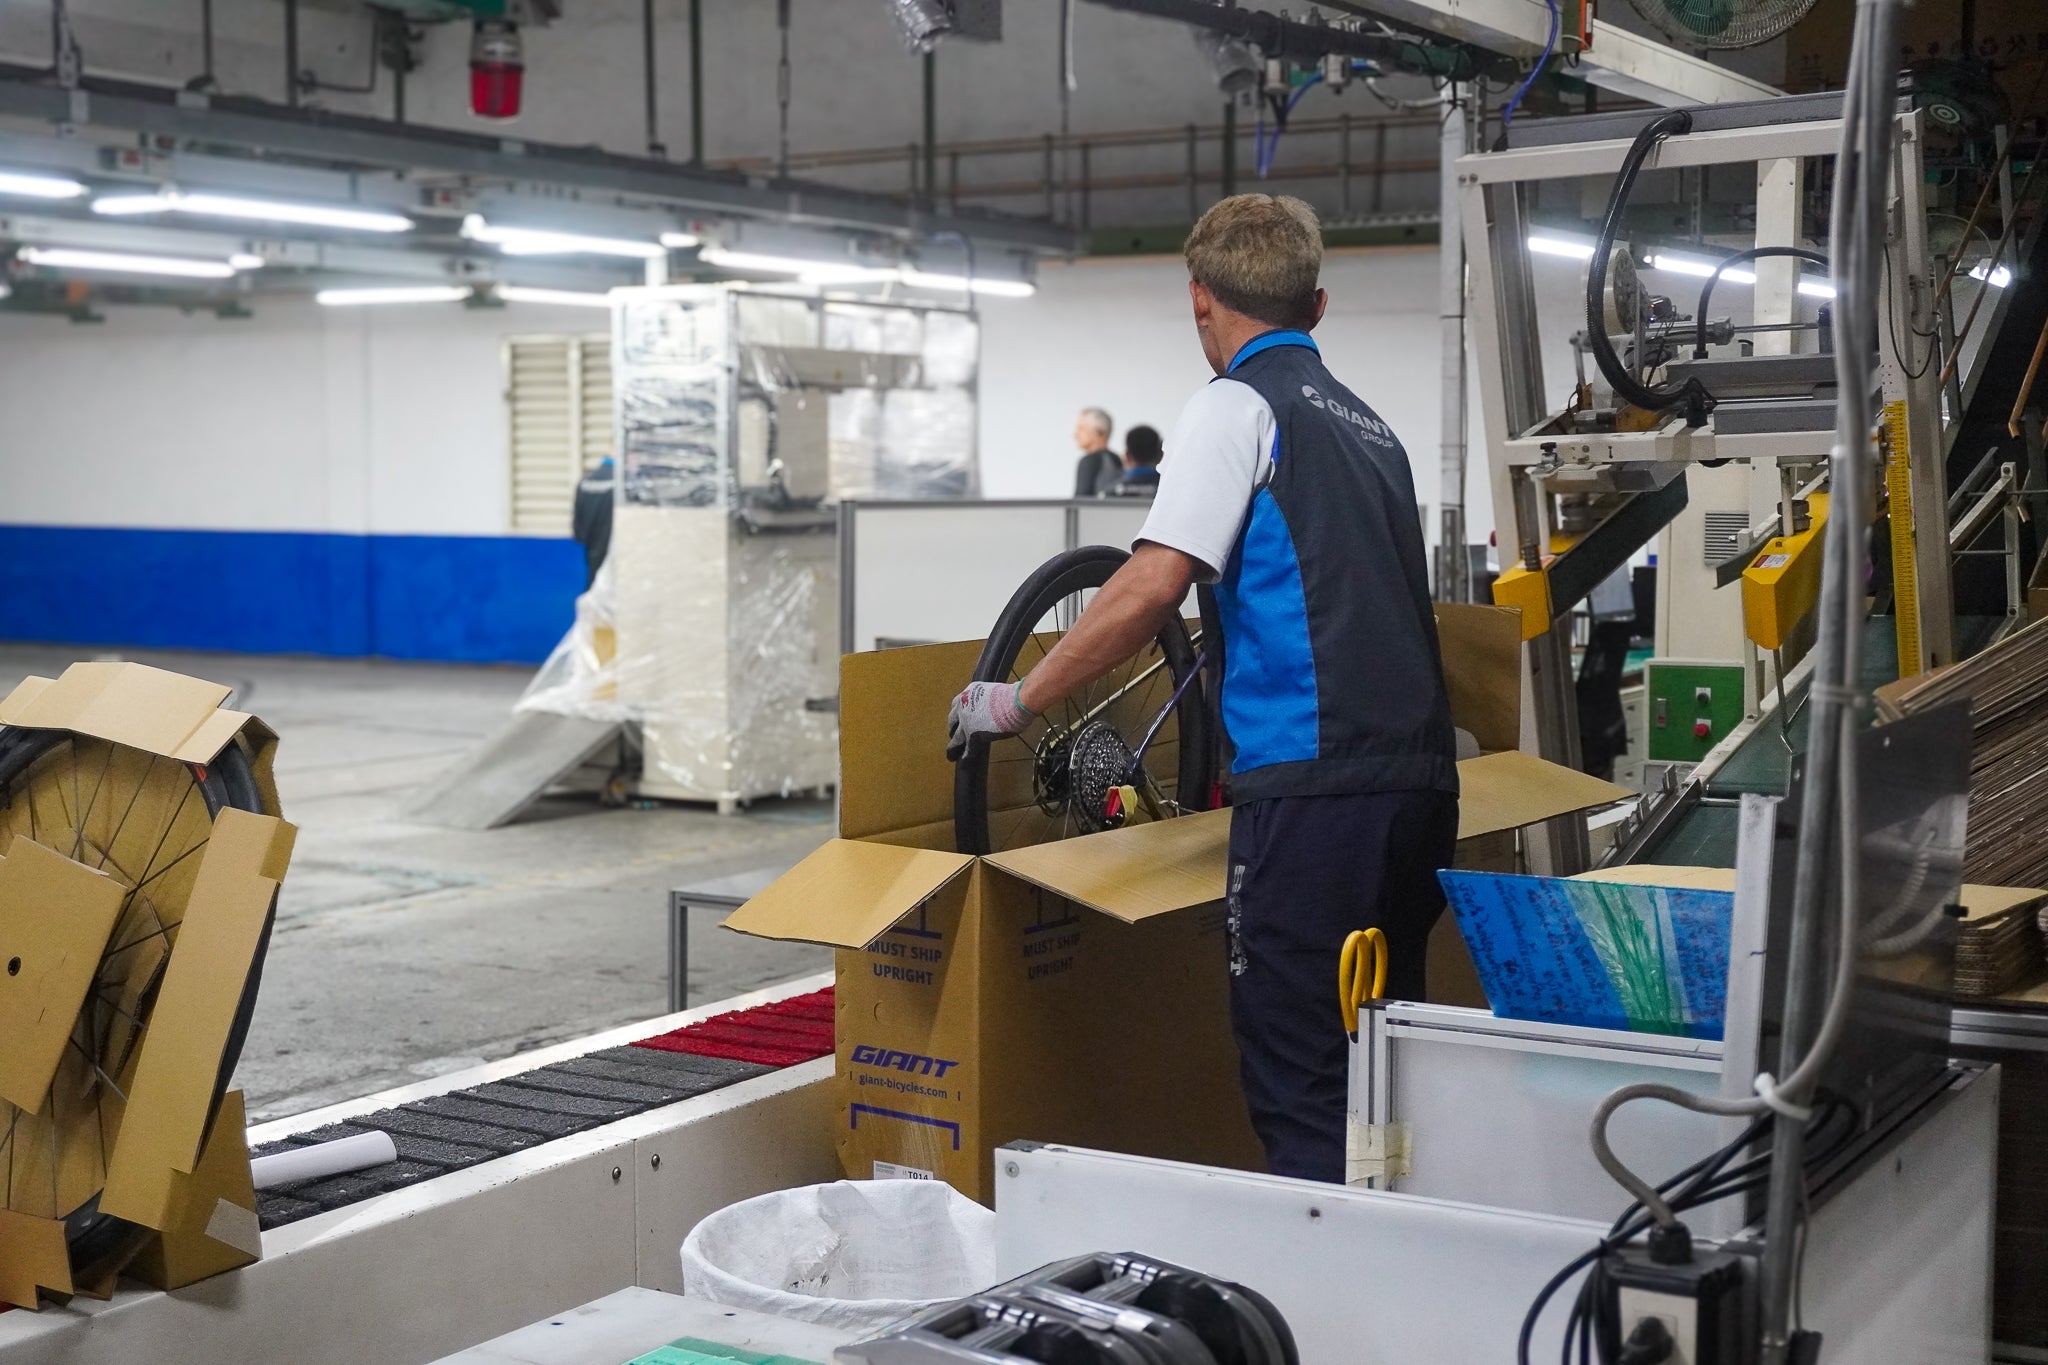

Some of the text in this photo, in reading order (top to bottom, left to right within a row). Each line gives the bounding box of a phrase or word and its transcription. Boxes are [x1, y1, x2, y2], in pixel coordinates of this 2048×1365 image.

[1327, 399, 1391, 437] GIANT
[1361, 431, 1394, 448] GROUP
[867, 940, 942, 962] MUST SHIP
[873, 963, 934, 985] UPRIGHT
[851, 1044, 960, 1078] GIANT
[859, 1073, 947, 1099] giant-bicycles.com
